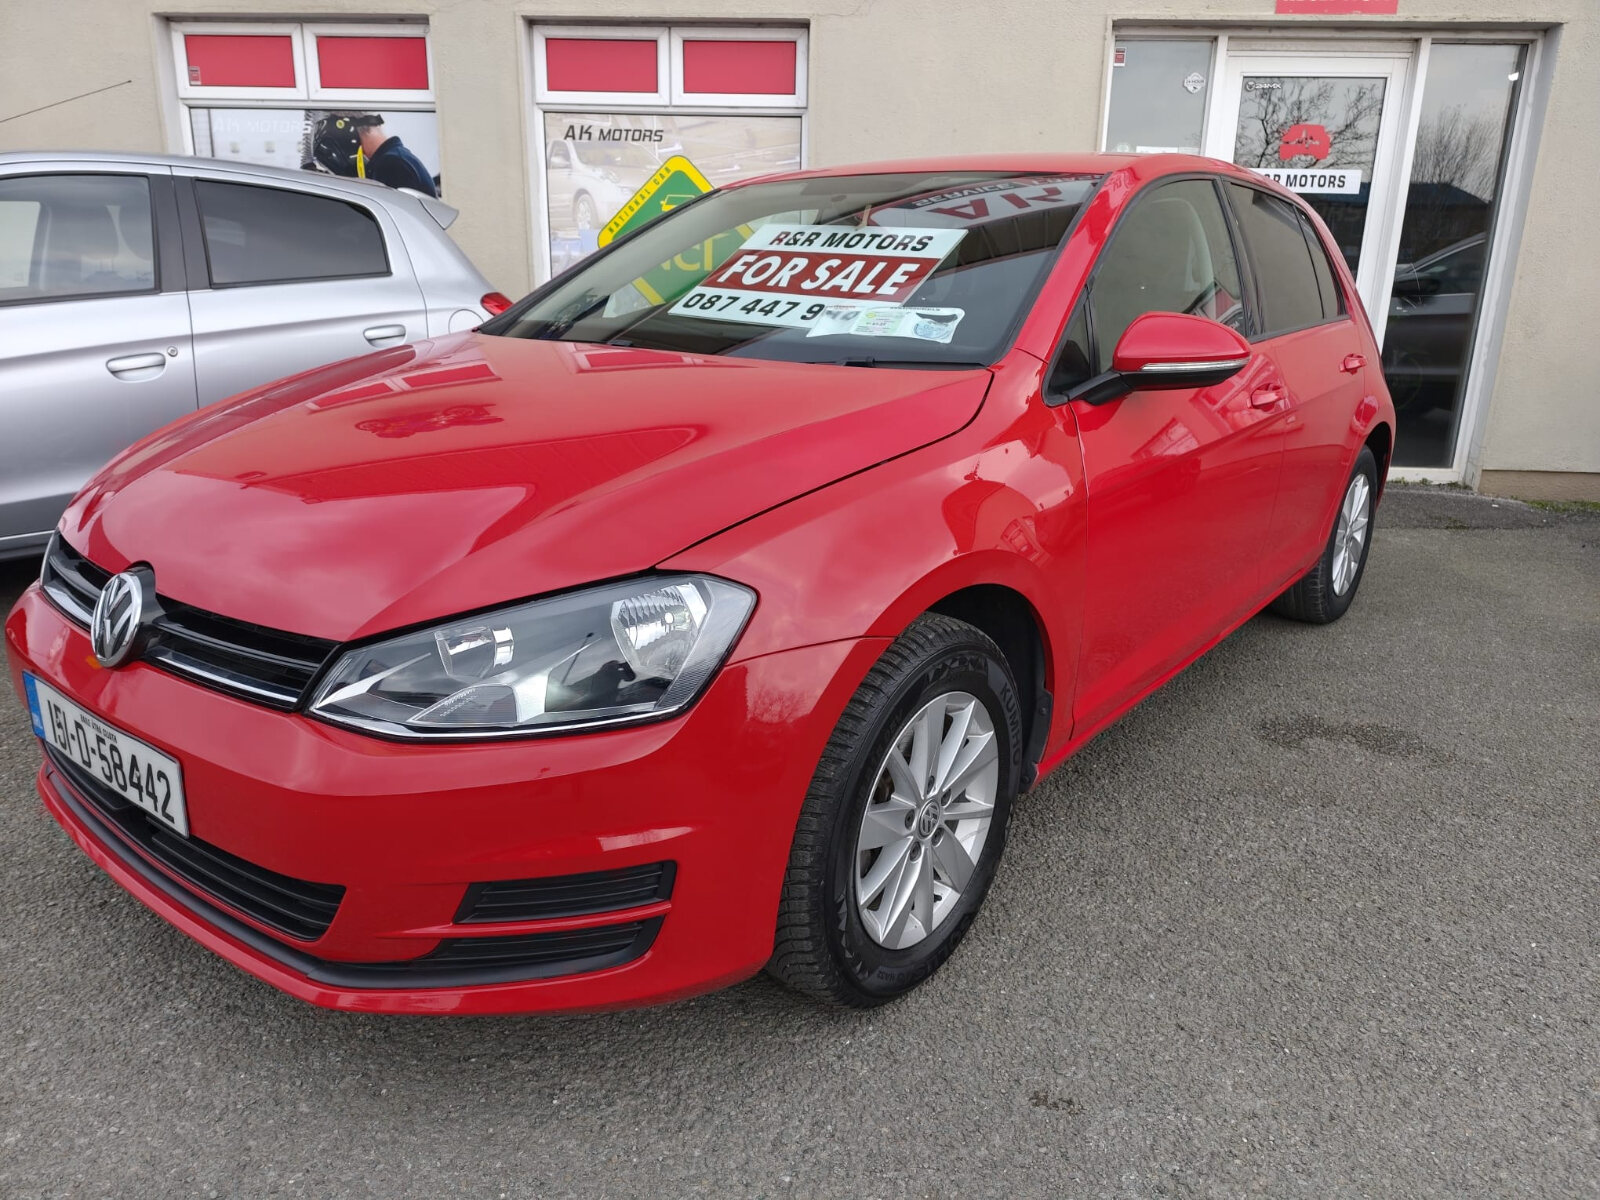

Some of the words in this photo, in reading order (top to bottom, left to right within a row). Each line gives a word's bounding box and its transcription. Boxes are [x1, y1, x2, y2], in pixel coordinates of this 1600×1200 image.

[564, 124, 593, 141] AK
[598, 128, 664, 142] MOTORS
[1285, 174, 1346, 188] MOTORS
[608, 189, 651, 234] NATIONAL
[653, 166, 672, 186] CAR
[769, 230, 819, 248] R&R
[820, 231, 934, 252] MOTORS
[717, 254, 809, 288] FOR
[801, 258, 919, 296] SALE
[682, 293, 741, 312] 087
[739, 298, 800, 320] 447
[1000, 682, 1021, 766] KUMHO
[47, 699, 175, 825] 151-D-58442
